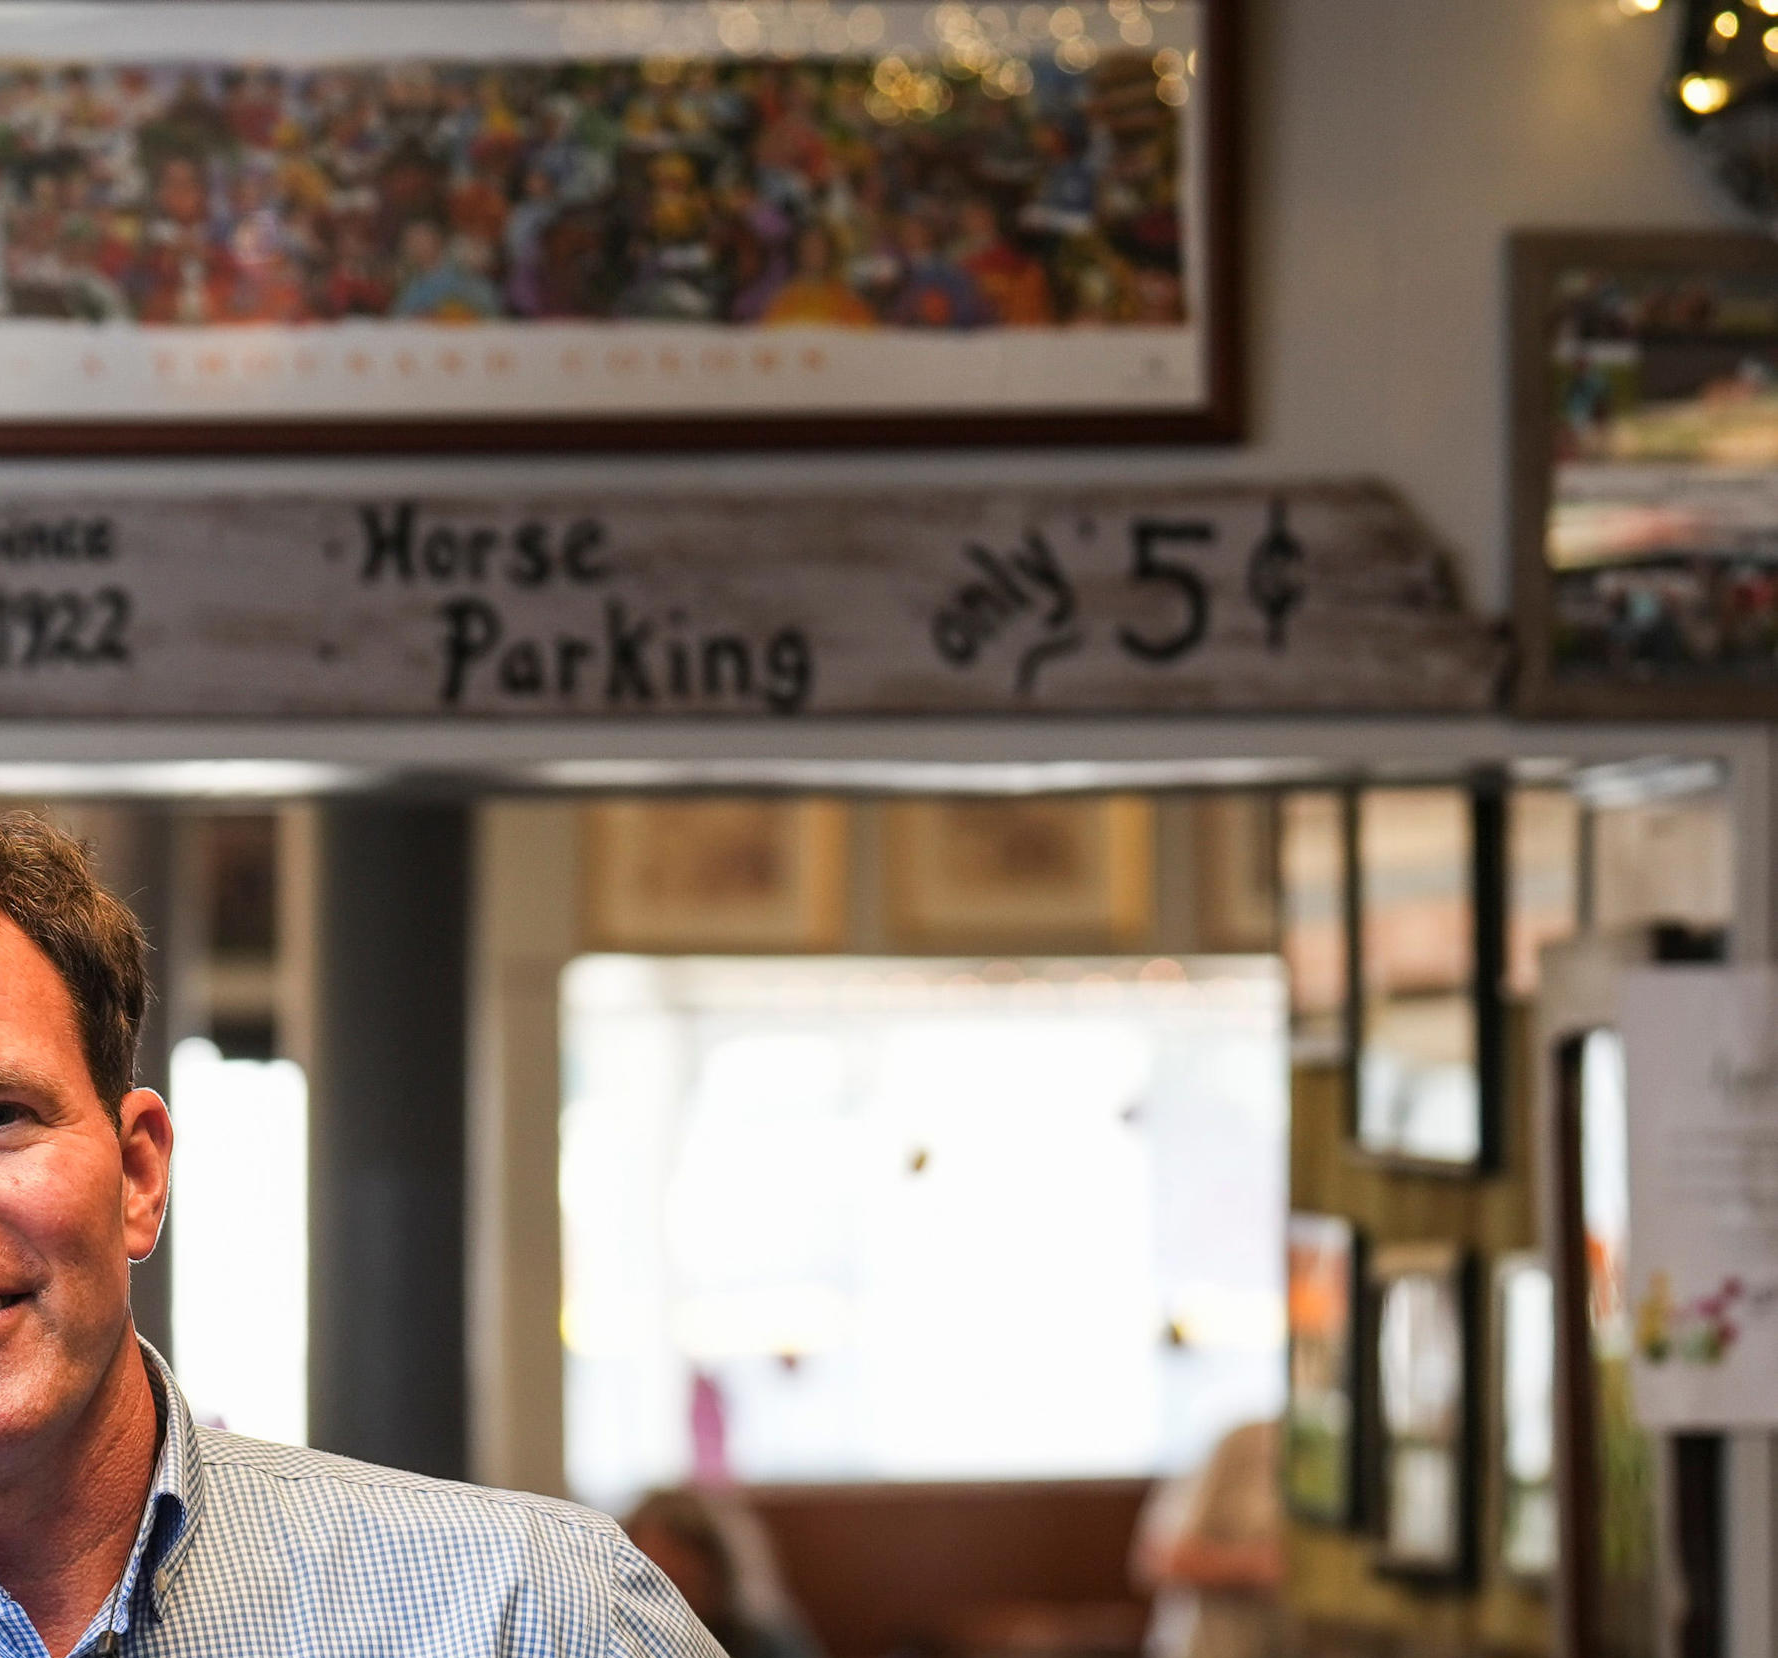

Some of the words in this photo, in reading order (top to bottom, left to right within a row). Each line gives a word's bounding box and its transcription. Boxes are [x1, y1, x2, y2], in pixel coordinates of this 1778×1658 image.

[357, 501, 614, 586] Horse
[435, 597, 815, 717] Parking
[930, 529, 1084, 695] only
